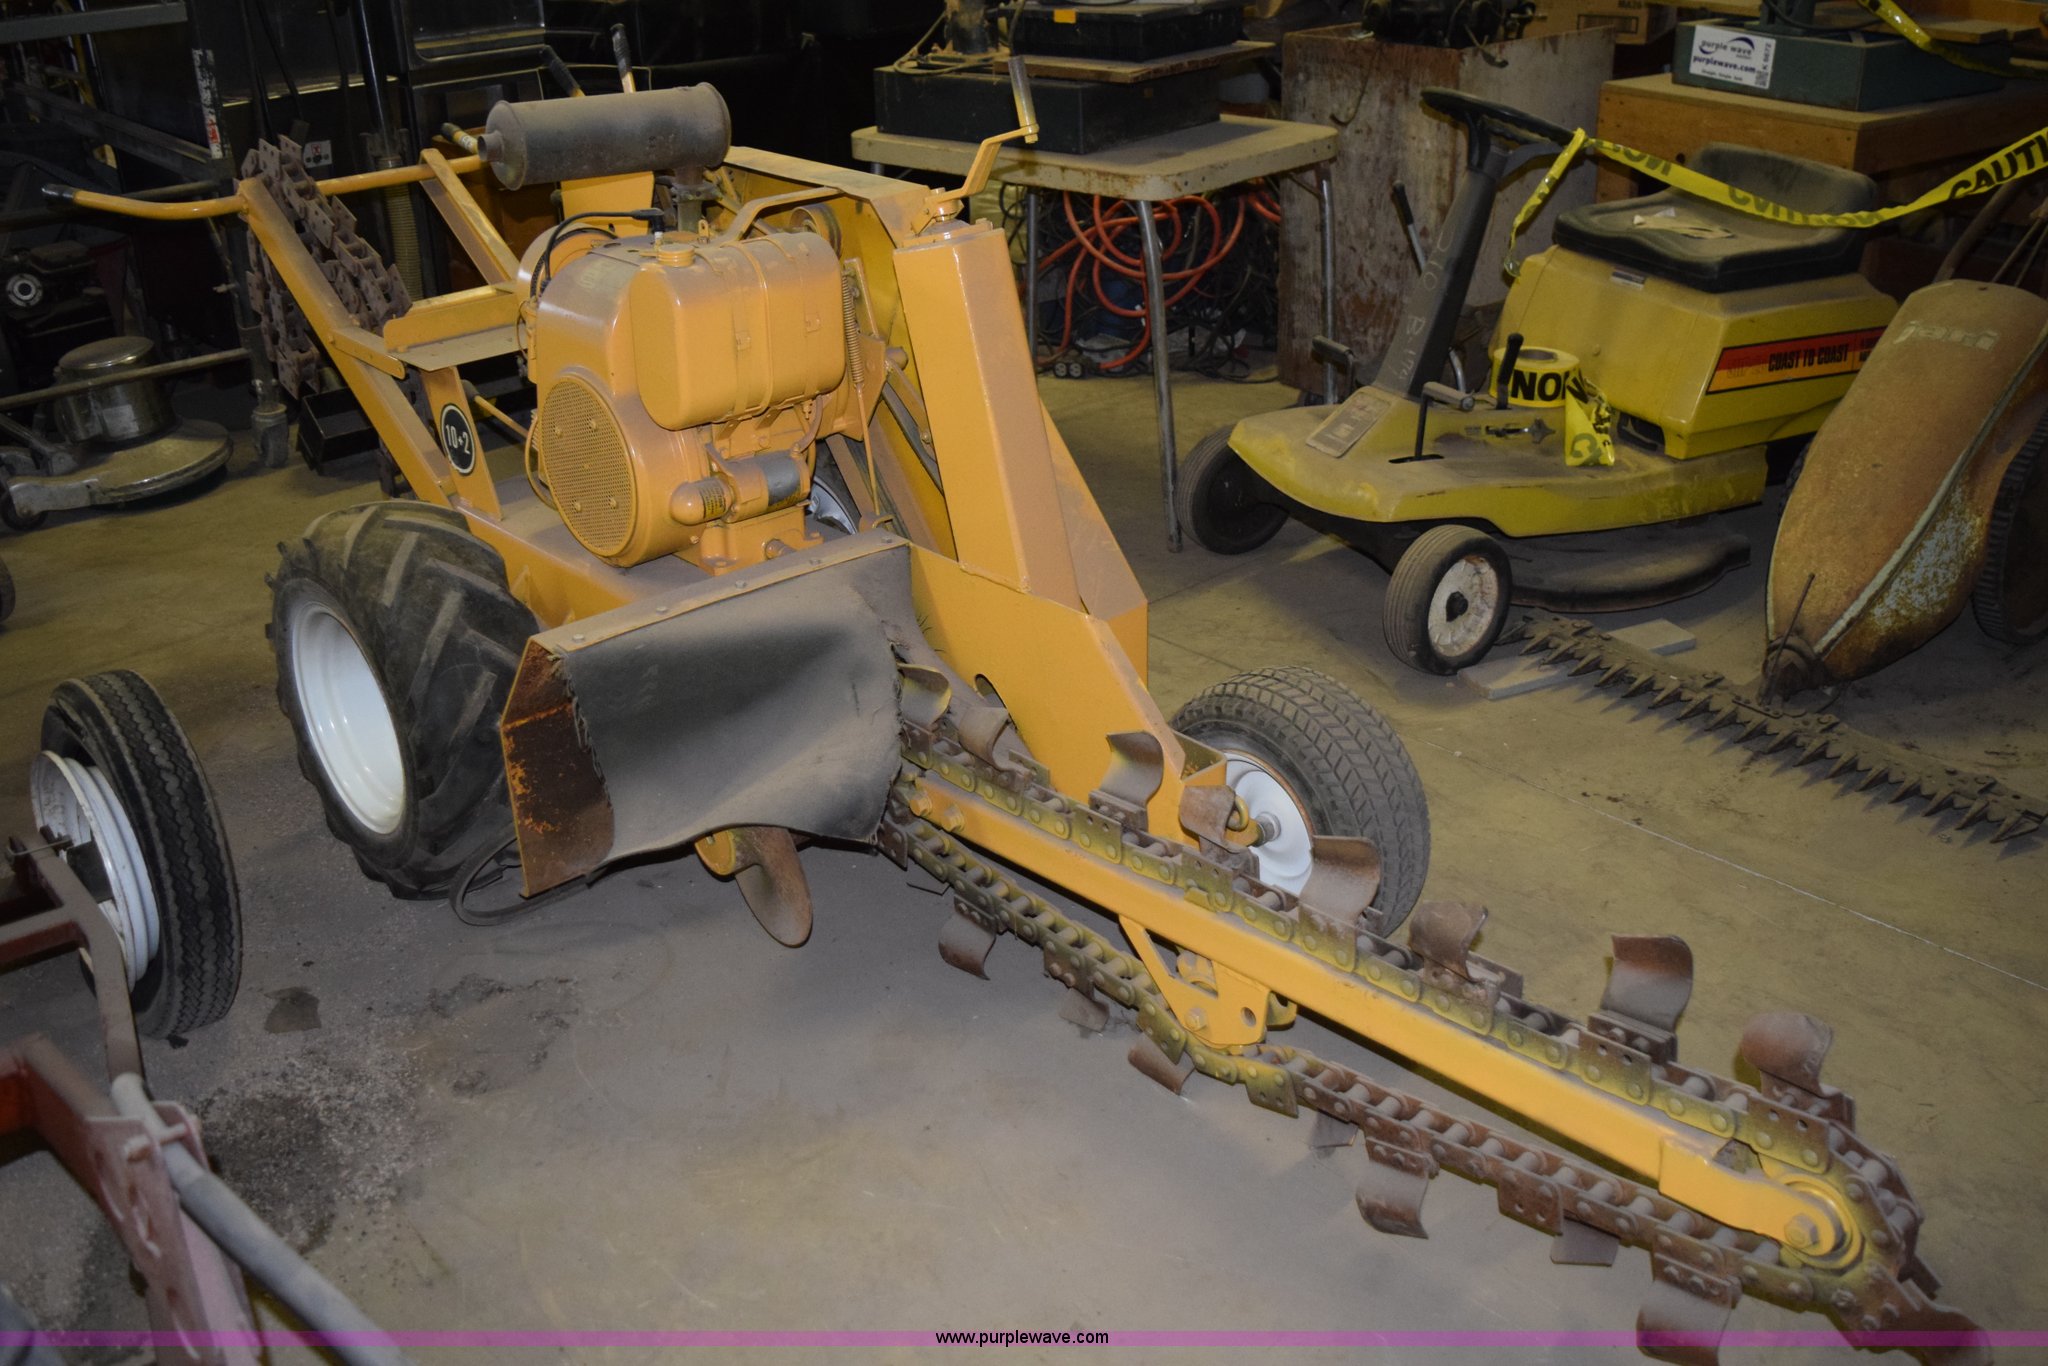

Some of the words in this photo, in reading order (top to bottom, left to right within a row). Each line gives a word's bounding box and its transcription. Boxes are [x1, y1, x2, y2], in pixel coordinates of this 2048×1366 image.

[1701, 40, 1728, 51] purple
[1730, 45, 1752, 55] wave
[1693, 55, 1756, 74] purplewave.com
[1768, 350, 1799, 372] COAST
[1802, 348, 1815, 367] TO
[1817, 343, 1849, 364] COAST
